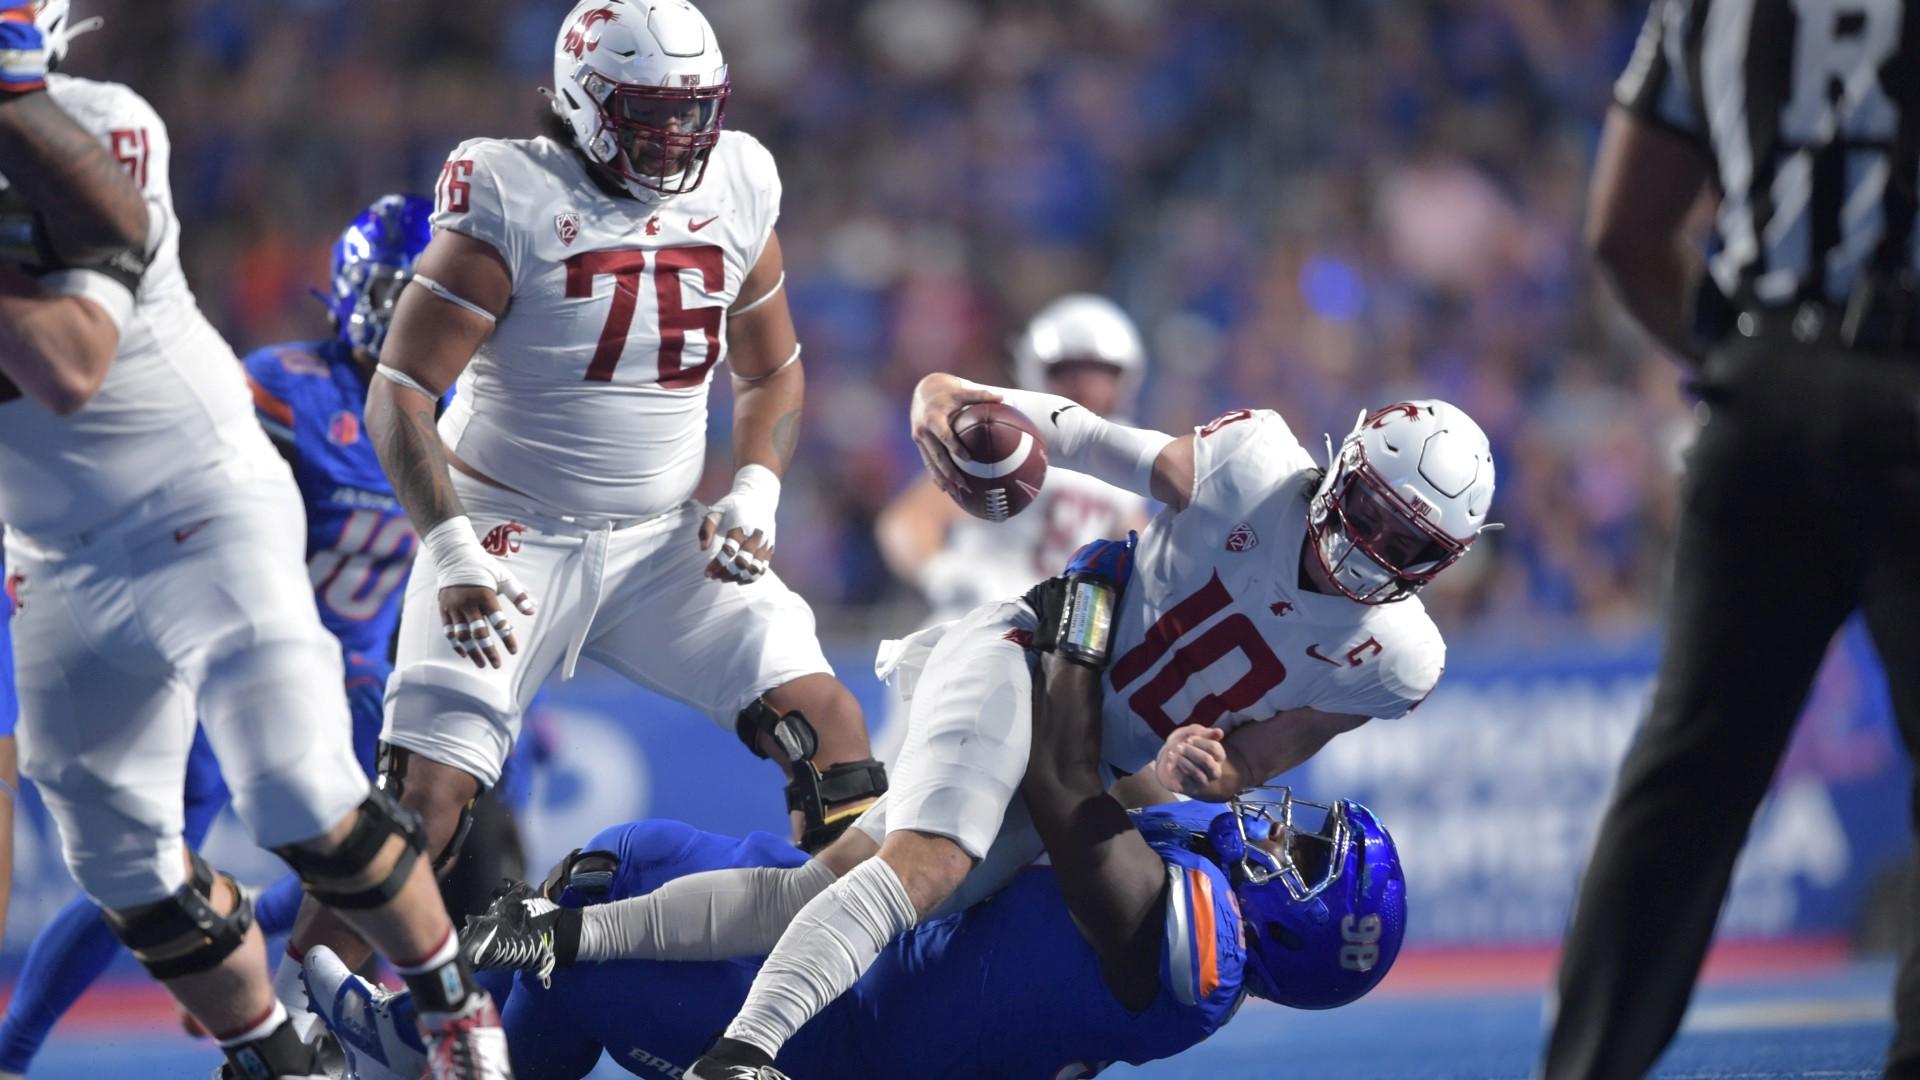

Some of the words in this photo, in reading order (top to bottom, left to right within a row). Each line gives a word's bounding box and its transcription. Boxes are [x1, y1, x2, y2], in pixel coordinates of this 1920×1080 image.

[1778, 0, 1901, 143] R
[560, 245, 725, 389] 76
[1110, 566, 1287, 742] 10
[1345, 636, 1383, 668] C
[1340, 913, 1382, 972] 86
